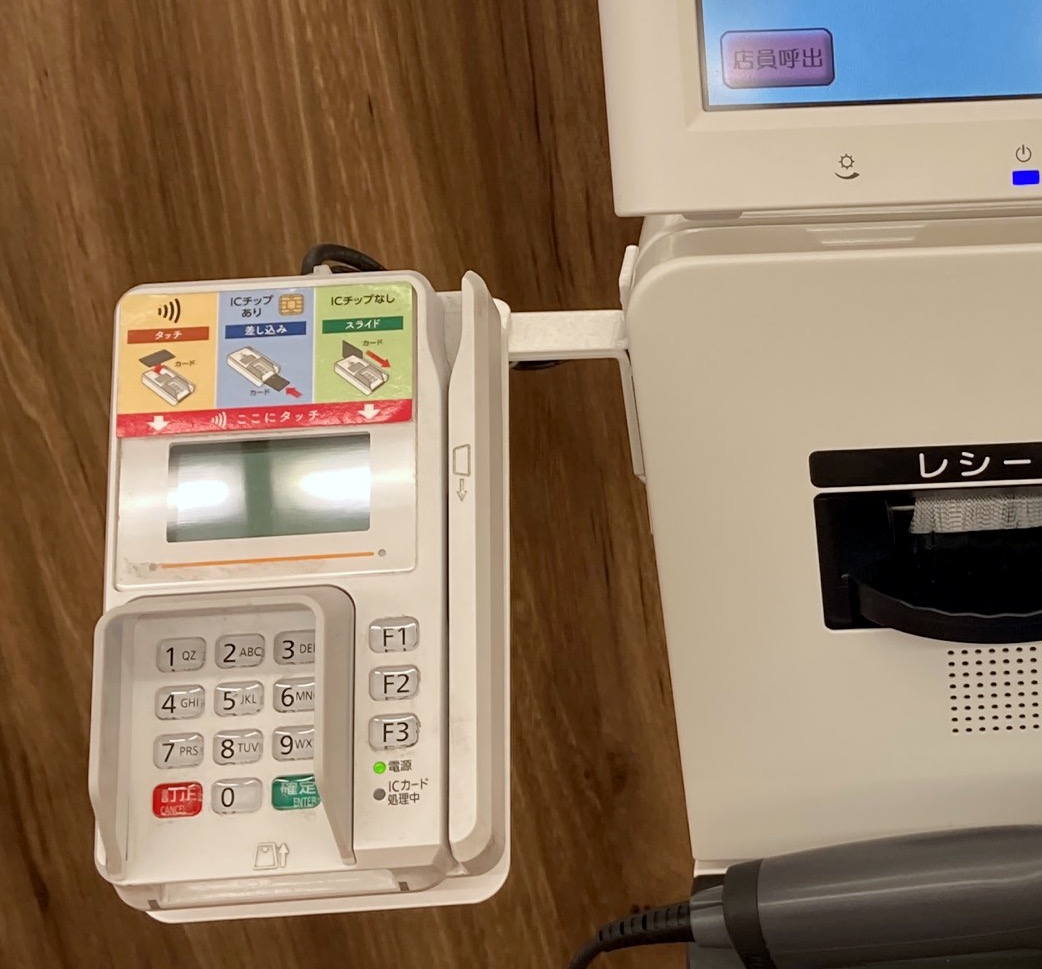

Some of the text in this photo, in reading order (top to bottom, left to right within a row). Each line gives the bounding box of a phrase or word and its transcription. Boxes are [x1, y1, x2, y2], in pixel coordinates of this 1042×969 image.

[733, 48, 813, 70] 店員呼出
[230, 294, 274, 307] ICチップ
[330, 293, 396, 306] ICチップなし
[241, 308, 262, 318] あり
[244, 324, 288, 336] 差し込み
[344, 319, 381, 330] スライド
[154, 330, 183, 340] タッチ
[362, 338, 383, 347] カード
[174, 359, 196, 368] カード
[249, 388, 271, 397] カード
[236, 410, 320, 425] ここにタッチ
[383, 627, 407, 647] F1
[166, 647, 197, 666] 1 QZ
[223, 643, 263, 663] 2 ABC
[281, 640, 295, 660] 3
[383, 673, 410, 694] F2
[161, 694, 199, 714] 4 GHI
[223, 691, 257, 711] 5 JKL
[281, 687, 314, 707] 6 MN
[382, 721, 410, 743] F3
[162, 743, 199, 763] 7 PRS
[221, 739, 259, 759] 8 TUV
[280, 735, 313, 755] 9 WX
[388, 759, 413, 773] 電源
[280, 781, 317, 796] 確定
[388, 777, 429, 793] ICカード
[221, 787, 235, 808] 0
[387, 792, 421, 806] 処理中
